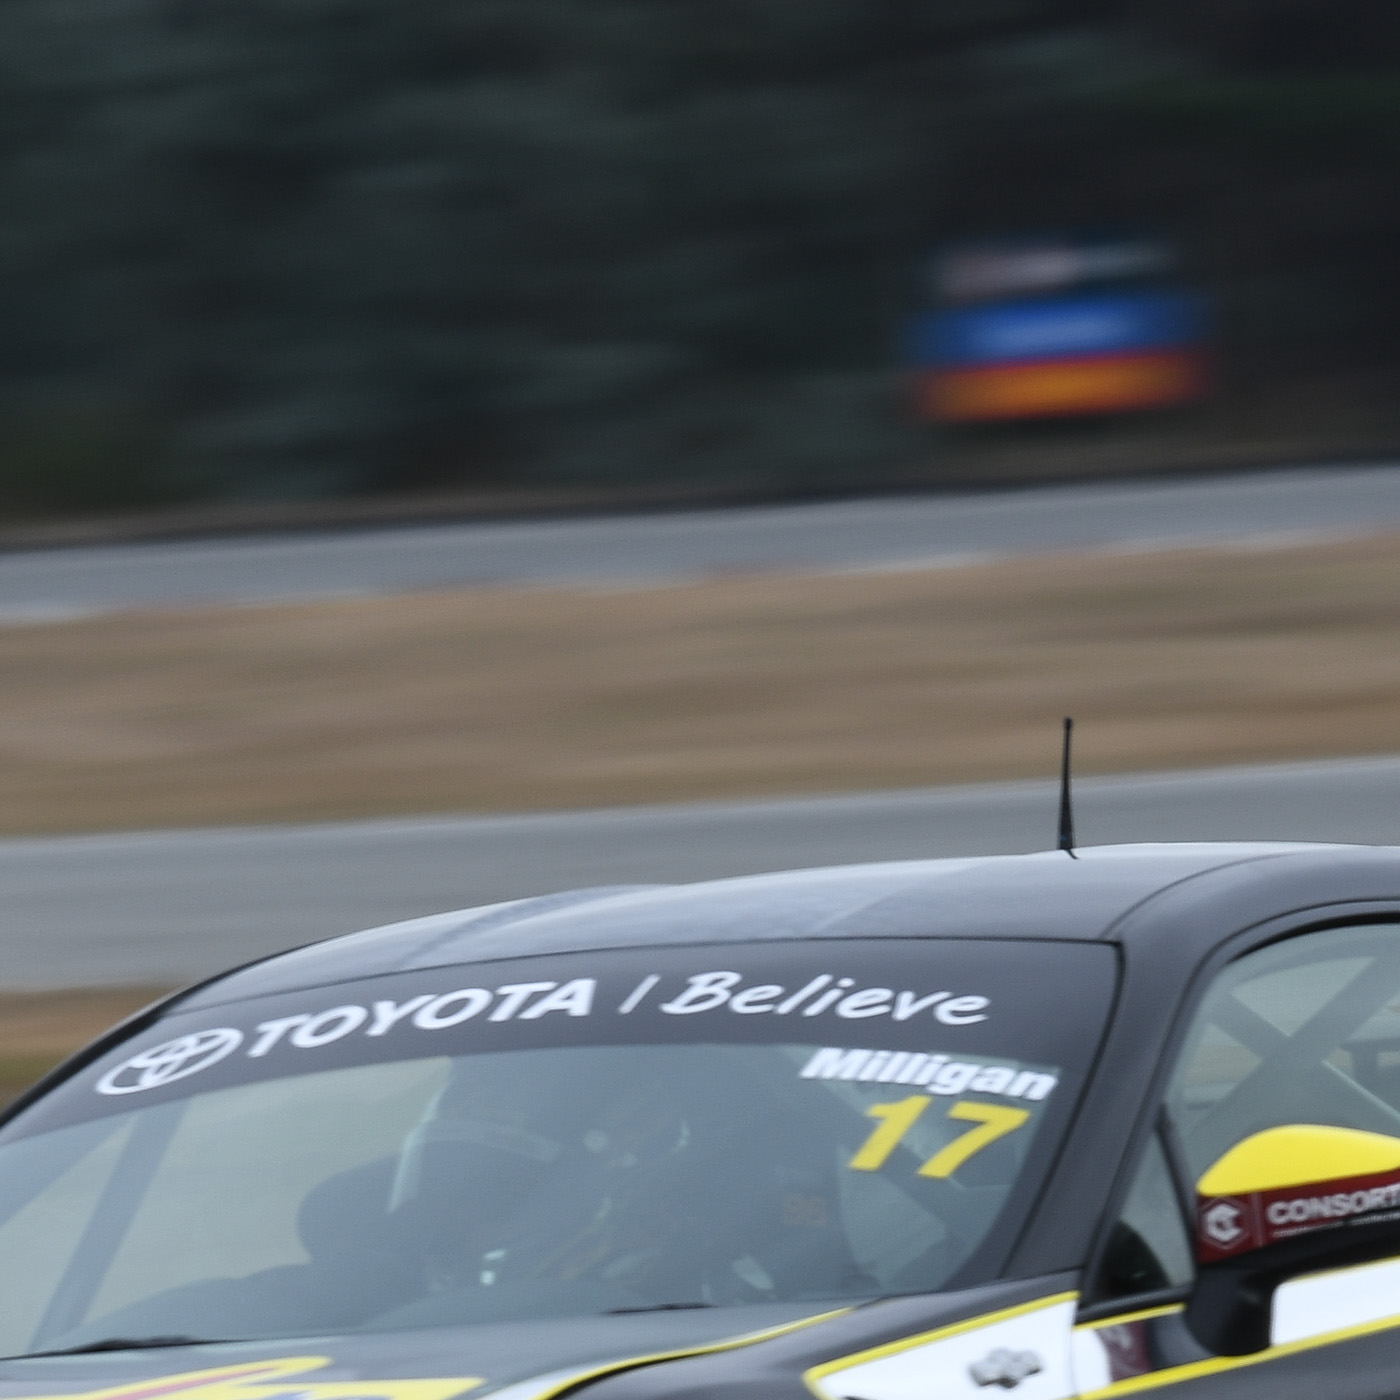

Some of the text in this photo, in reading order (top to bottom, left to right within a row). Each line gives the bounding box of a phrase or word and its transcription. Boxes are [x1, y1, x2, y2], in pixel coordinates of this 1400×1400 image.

[247, 971, 992, 1058] TOYOTA Believe
[799, 1046, 1059, 1100] Milligan
[849, 1094, 1032, 1179] 17
